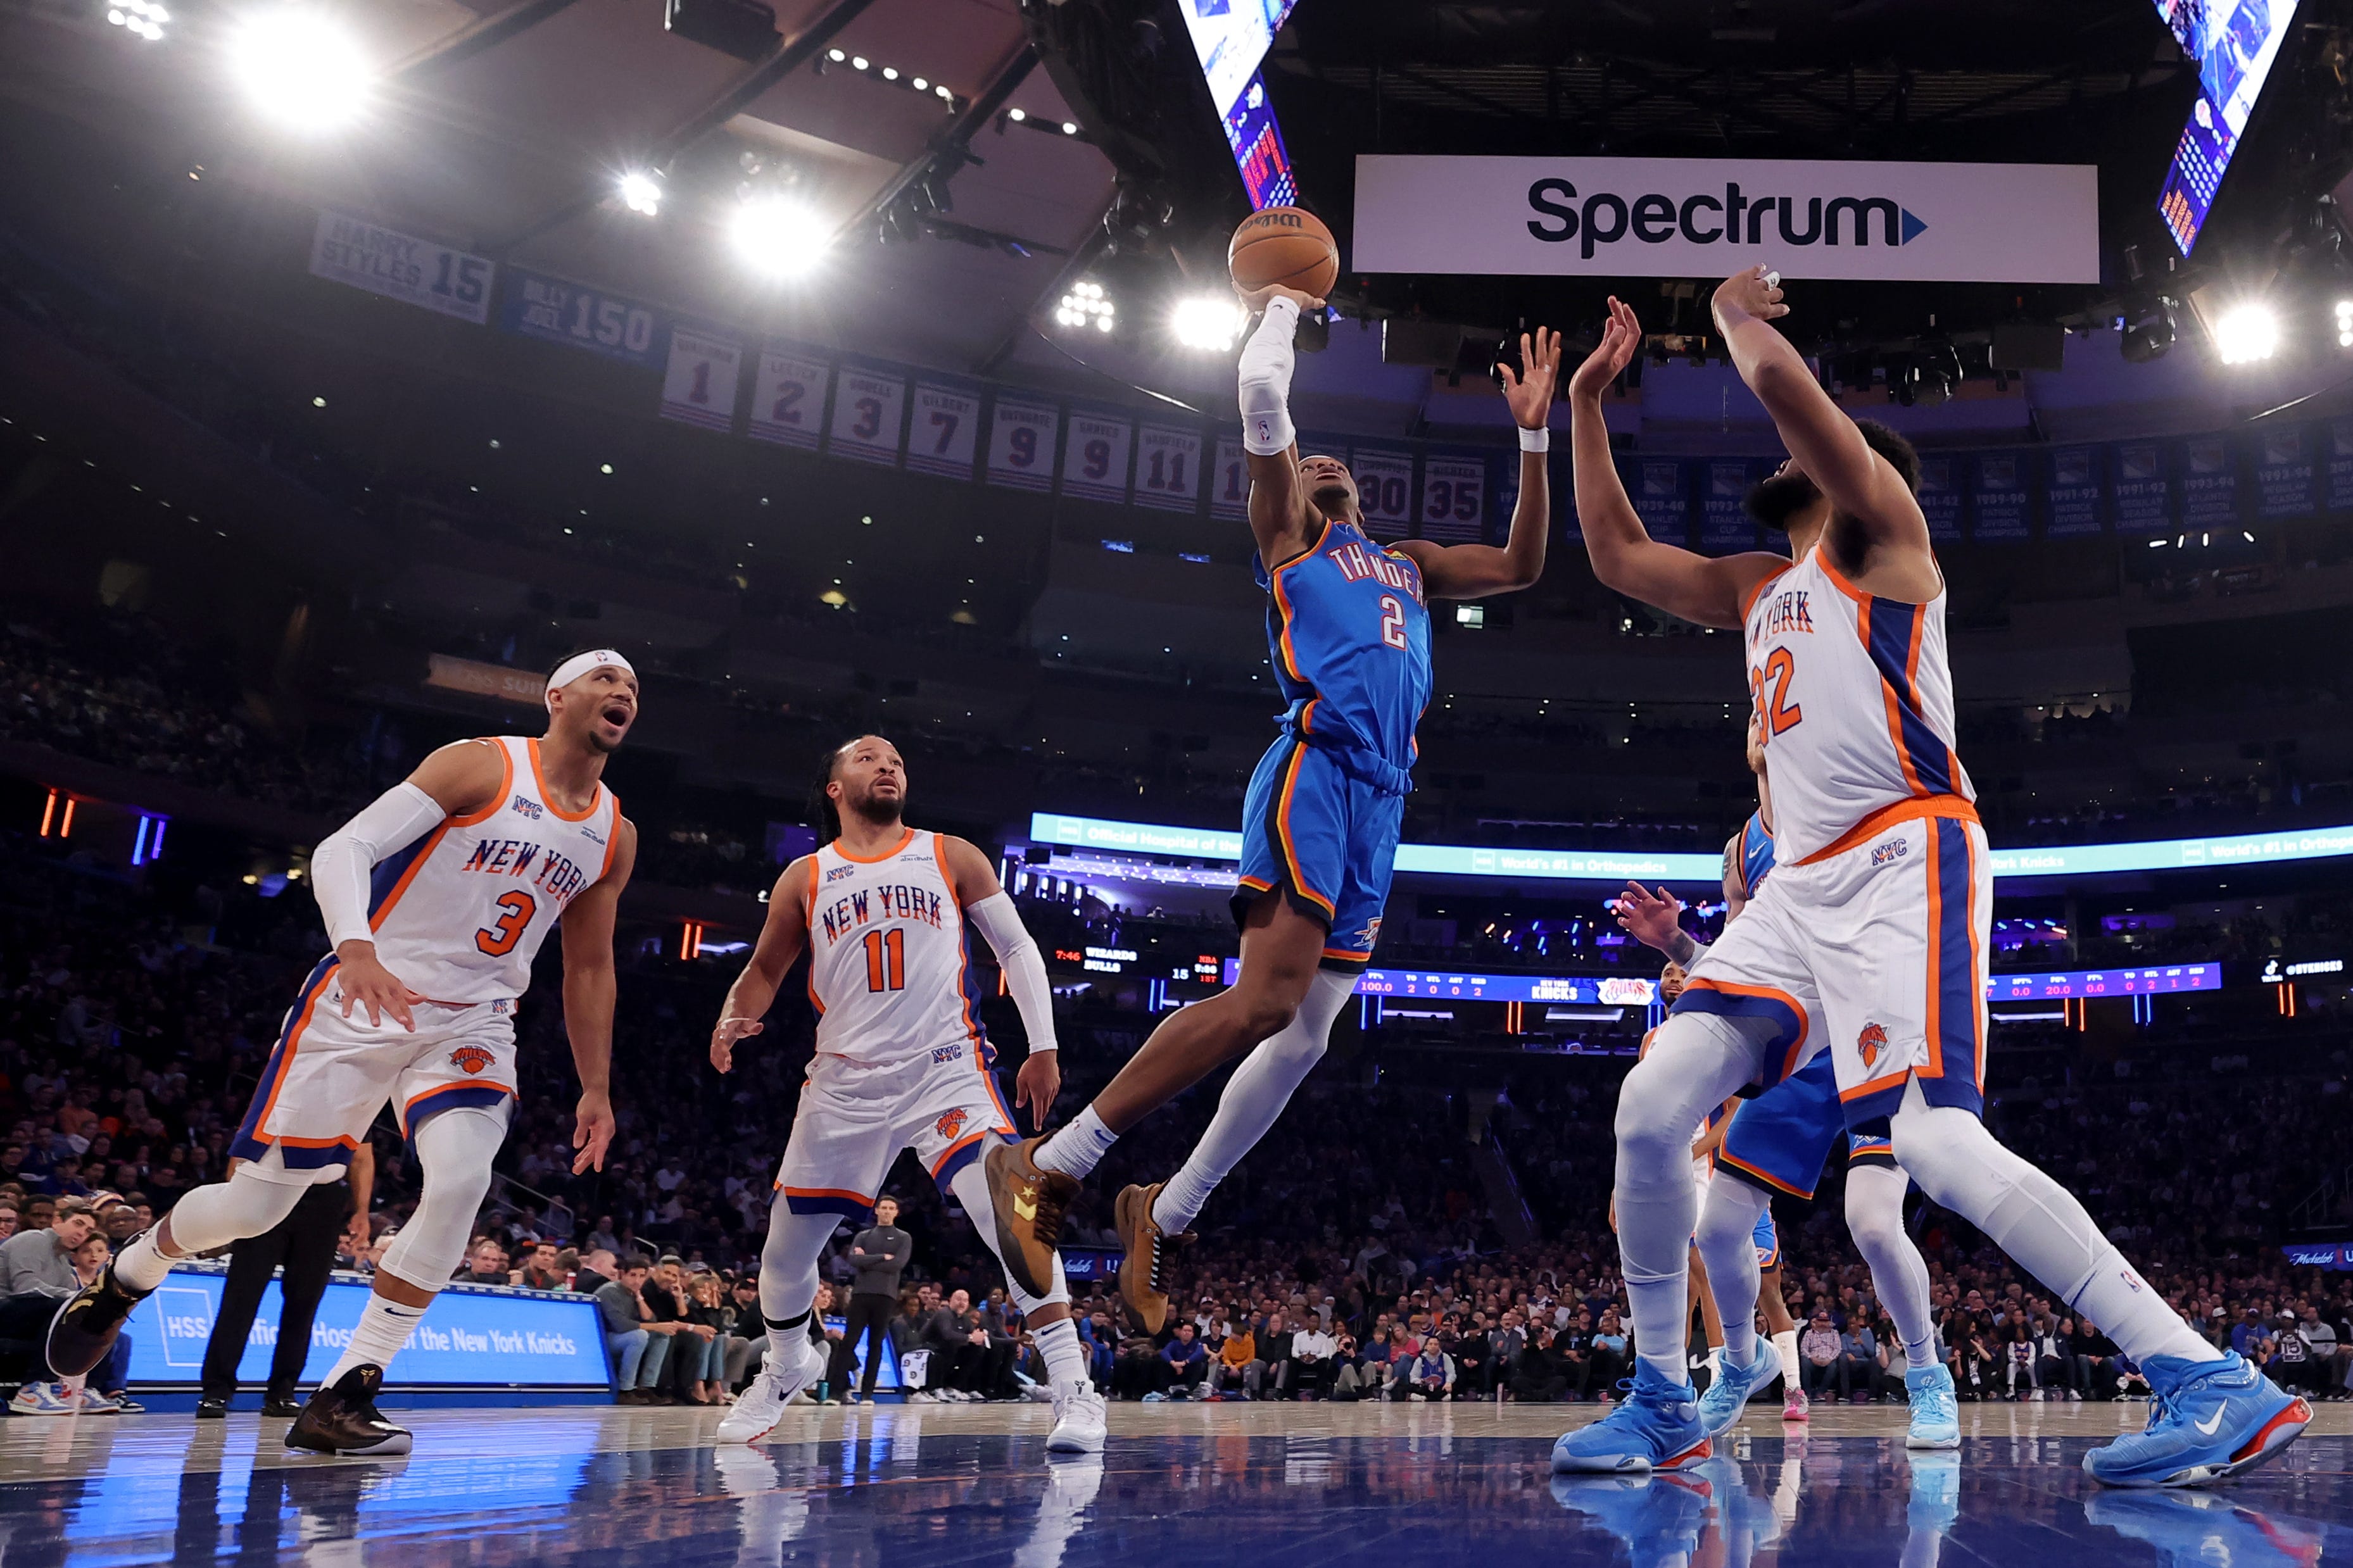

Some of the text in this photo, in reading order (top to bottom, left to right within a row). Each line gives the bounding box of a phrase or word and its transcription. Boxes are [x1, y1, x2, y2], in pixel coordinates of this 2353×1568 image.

[1527, 177, 1899, 260] Spectrum
[322, 239, 421, 287] STYLES
[431, 253, 487, 303] 15
[571, 294, 653, 353] 150
[689, 360, 710, 405] 1
[773, 380, 805, 424] 2
[922, 394, 969, 415] GILBERT
[852, 398, 882, 439] 3
[931, 411, 959, 455] 7
[1009, 427, 1037, 468] 9
[1082, 439, 1111, 480] 9
[1147, 449, 1185, 493] 11
[1357, 474, 1406, 516] 30
[1427, 480, 1479, 521] 35
[1977, 493, 2026, 505] 1989-90
[2050, 487, 2099, 501] 1991-92
[2117, 482, 2166, 496] 1991-92
[1636, 501, 1685, 511] 1939-40
[1379, 593, 1408, 652] 2
[1751, 645, 1802, 746] 32
[512, 795, 543, 820] NYC
[1087, 826, 1137, 844] Official
[1140, 832, 1199, 849] Hospital
[1201, 839, 1216, 850] of
[2210, 843, 2261, 858] World's
[2264, 841, 2281, 853] #1
[2283, 839, 2298, 851] in
[1501, 855, 1549, 869] World's
[1552, 858, 1568, 869] #1
[1571, 857, 1584, 870] in
[1587, 858, 1667, 874] Orthopedics
[1871, 838, 1907, 867] NYC
[2020, 856, 2065, 868] Knicks
[461, 839, 588, 913] NEW YORK
[826, 864, 854, 882] NYC
[474, 889, 538, 958] 3
[822, 885, 942, 948] NEW YORK
[862, 928, 905, 993] 11
[1056, 947, 1137, 962] 7:46 WIZARDS
[1083, 959, 1121, 973] BULLS
[1198, 955, 1217, 964] NBA
[2286, 960, 2343, 975] @NYKNICKS
[1172, 969, 1189, 980] 15
[2012, 988, 2030, 996] 0.0
[2046, 986, 2071, 994] 20.0
[2086, 984, 2105, 993] 0.0
[2126, 982, 2134, 991] 0
[2147, 981, 2155, 989] 2
[2171, 979, 2178, 988] 1
[2192, 978, 2200, 986] 2
[1361, 982, 1482, 996] 100.0 2 0 0 2
[1531, 986, 1578, 1001] KNICKS
[931, 1044, 962, 1064] NYC
[167, 1315, 210, 1339] HSS
[419, 1326, 451, 1351] the
[451, 1327, 488, 1353] New
[488, 1329, 526, 1354] York
[526, 1331, 577, 1356] Knicks
